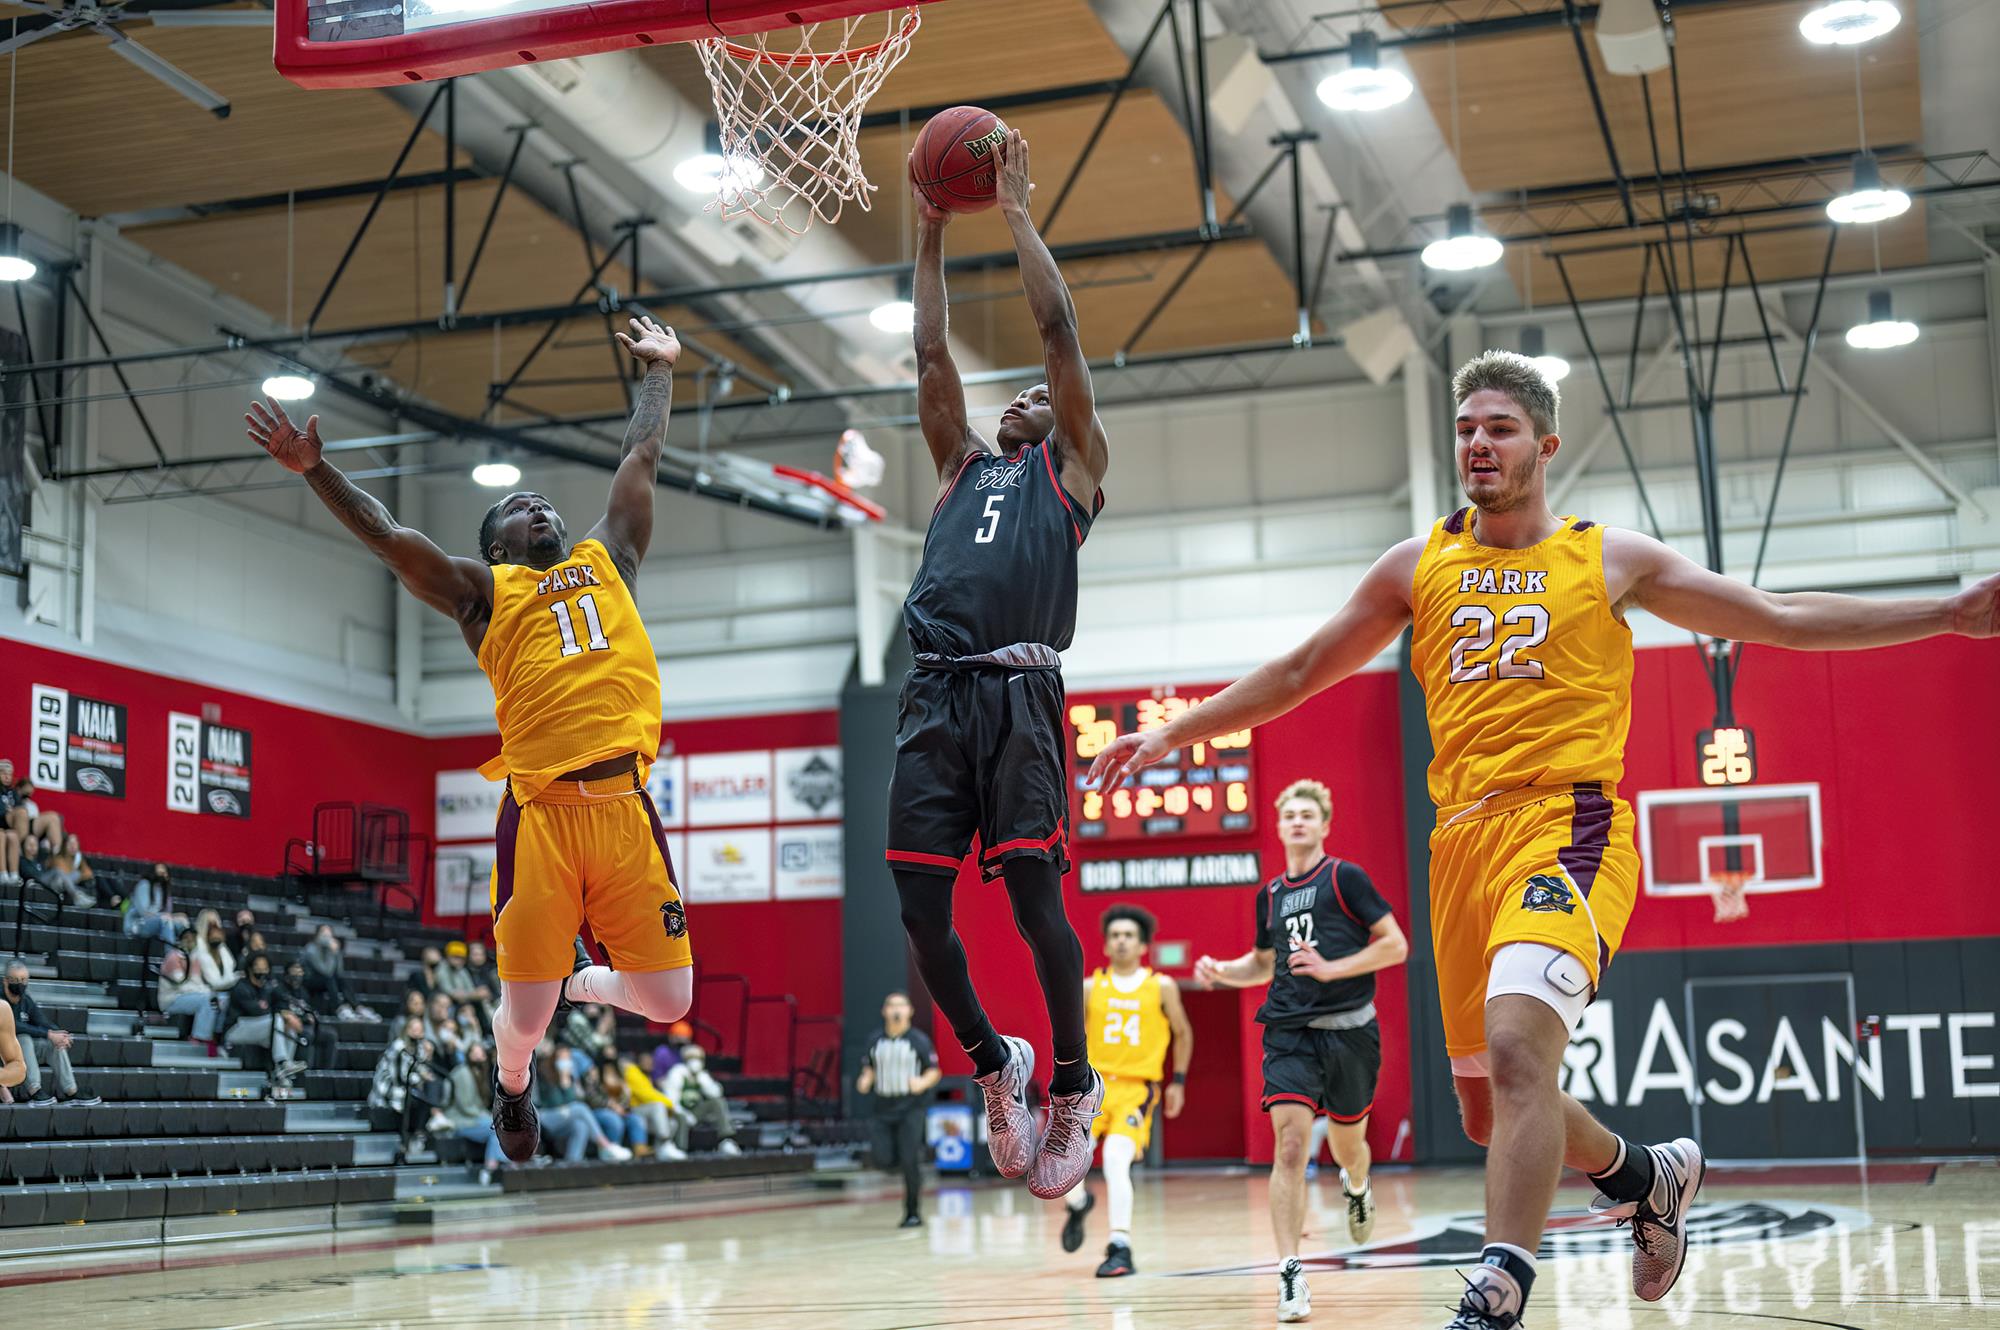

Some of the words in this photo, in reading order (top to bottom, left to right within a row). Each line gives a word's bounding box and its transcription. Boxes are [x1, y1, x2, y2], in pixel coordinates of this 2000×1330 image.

[975, 494, 1005, 543] 5
[538, 565, 600, 595] PARK
[1459, 568, 1548, 594] PARK
[549, 593, 610, 657] 11
[1449, 603, 1550, 684] 22
[38, 695, 61, 782] 2019
[77, 700, 118, 743] NAIA
[175, 723, 194, 804] 2021
[207, 726, 244, 766] NAIA
[1285, 912, 1319, 951] 32
[1103, 1012, 1141, 1046] 24
[1625, 997, 2000, 1106] ASANTE
